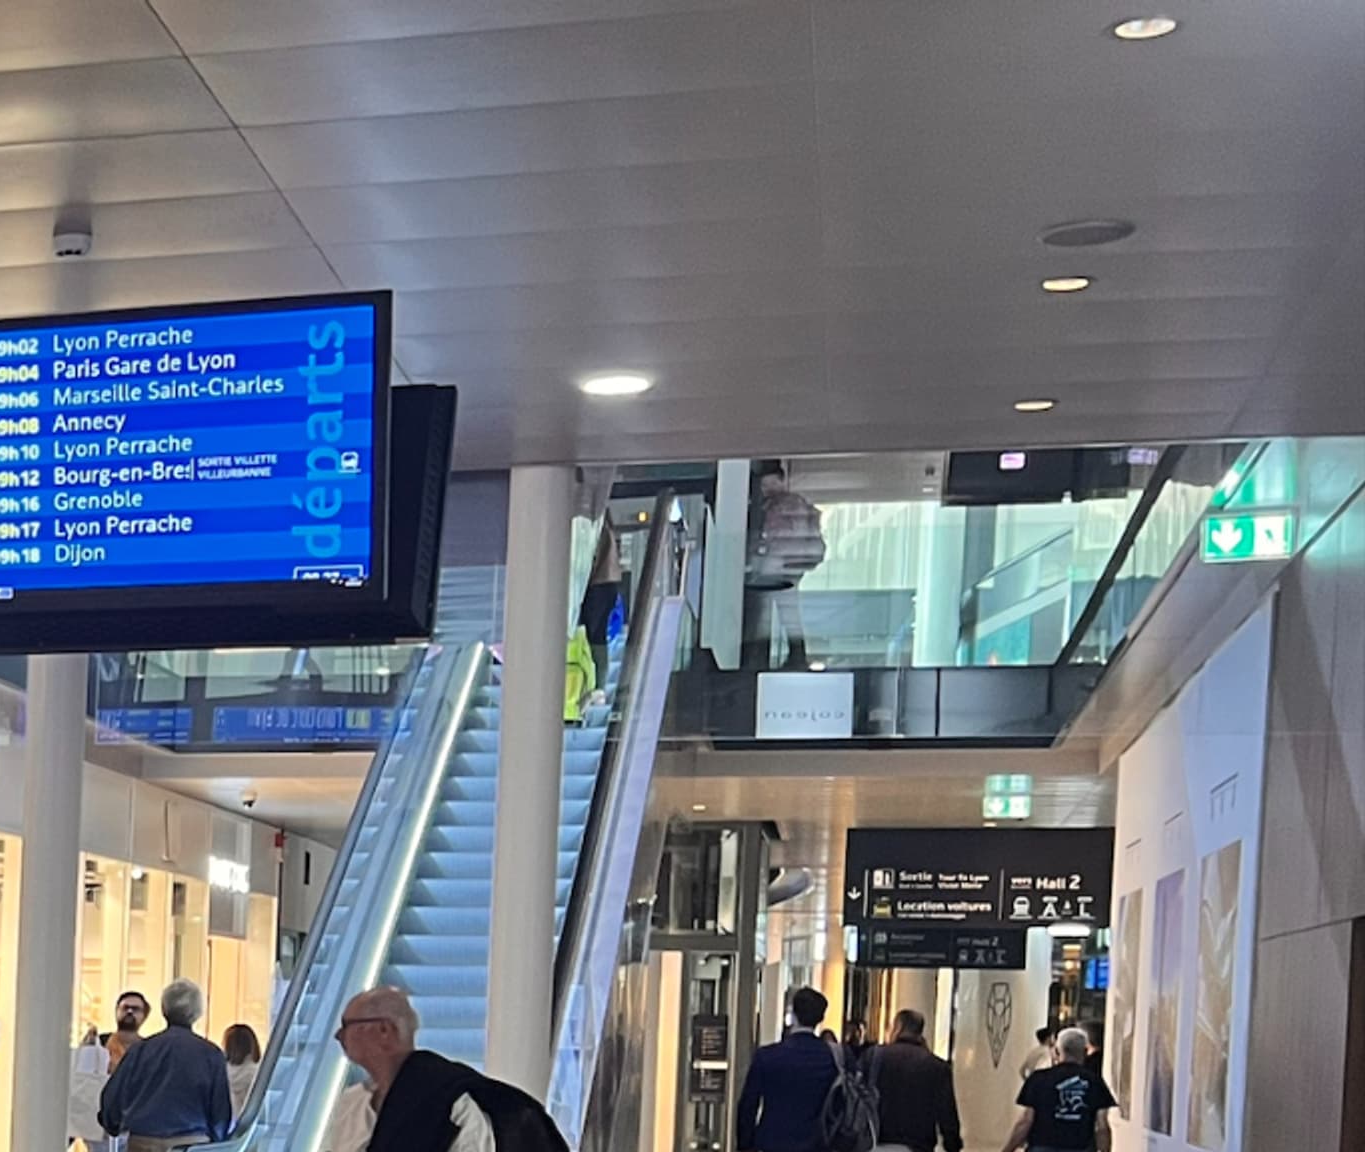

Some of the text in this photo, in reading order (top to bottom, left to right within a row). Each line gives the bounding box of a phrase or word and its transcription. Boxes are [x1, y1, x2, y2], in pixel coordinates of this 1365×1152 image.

[53, 334, 100, 356] Lyon
[106, 326, 193, 349] Perrache
[53, 358, 100, 379] Paris
[105, 357, 151, 376] Gare
[157, 353, 181, 372] de
[187, 352, 236, 374] Lyon
[53, 384, 142, 406] Marseille
[148, 376, 284, 400] Saint-Charles
[53, 413, 126, 433] Annecy
[53, 441, 100, 462] Lyon
[106, 435, 193, 456] Perrache
[291, 319, 356, 558] départs
[197, 453, 278, 468] SORTIE VILLETTE
[197, 466, 272, 480] VILLEURBANNE
[54, 490, 143, 511] Grenoble
[54, 519, 100, 541] Lyon
[106, 514, 193, 534] Perrache
[55, 544, 106, 566] Dijon
[899, 870, 933, 881] Sortie
[1036, 877, 1067, 889] Hall
[1069, 873, 1081, 889] 2
[897, 900, 992, 911] Location voitures
